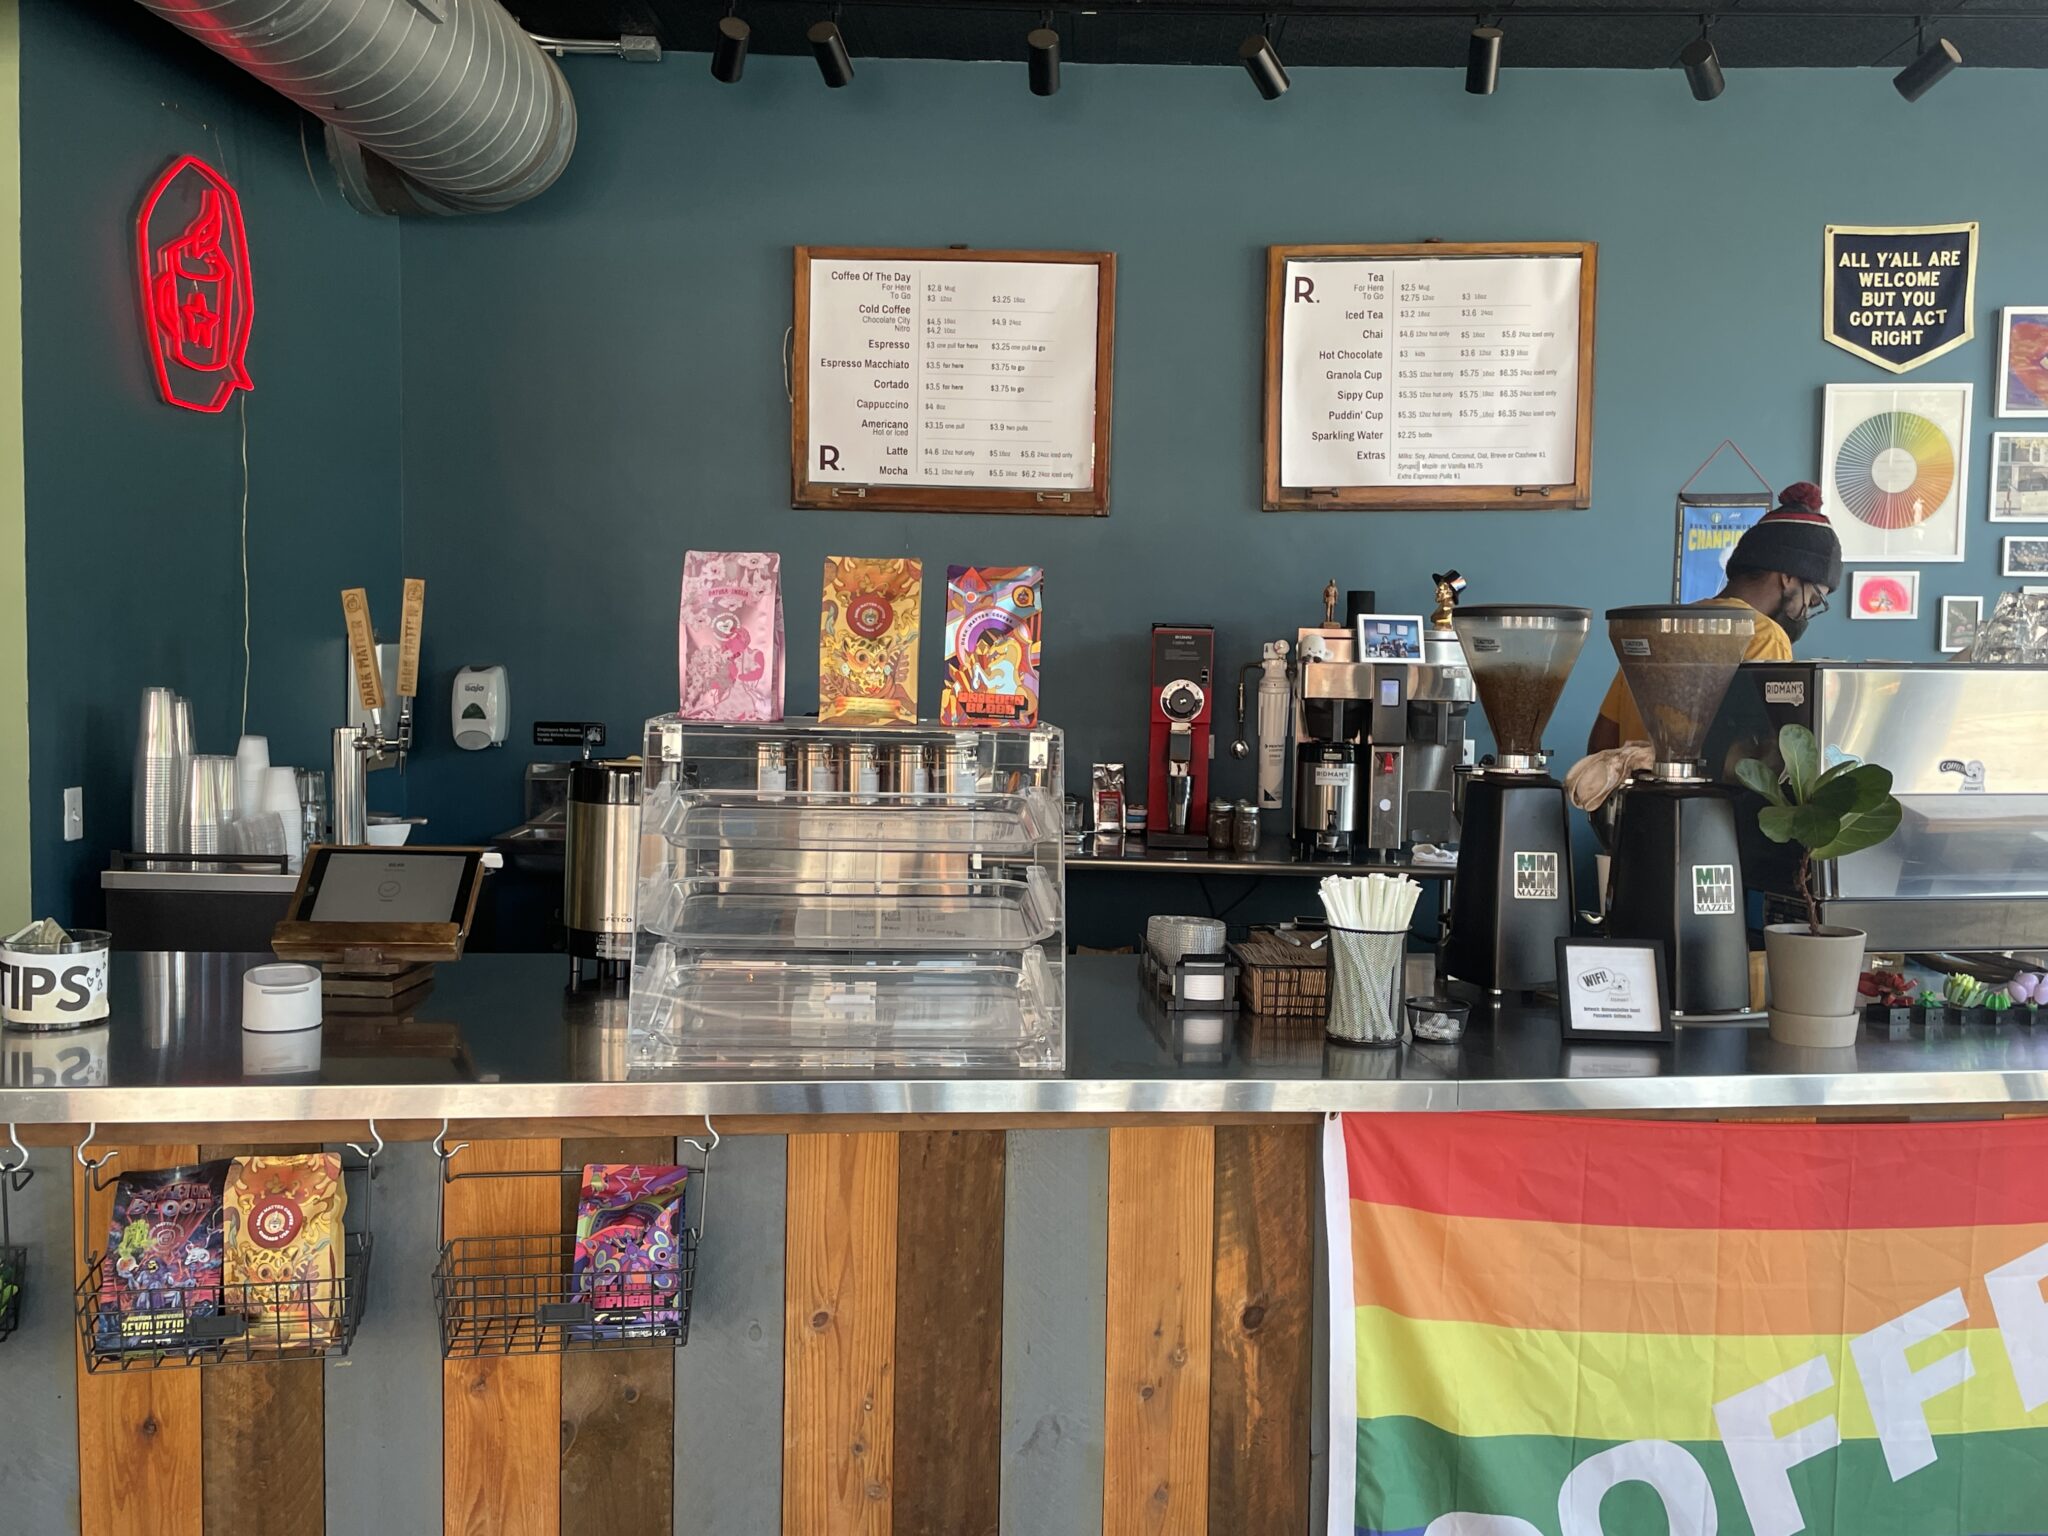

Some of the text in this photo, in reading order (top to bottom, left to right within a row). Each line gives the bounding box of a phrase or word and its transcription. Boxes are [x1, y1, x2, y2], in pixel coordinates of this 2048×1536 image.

[1839, 251, 1960, 267] ALL Y'ALL ARE
[831, 271, 911, 283] Coffee Of The Day
[1368, 273, 1384, 281] Tea
[1859, 271, 1940, 287] WELCOME
[1862, 291, 1935, 306] BUT YOU
[859, 304, 910, 314] Cold Coffee
[1346, 310, 1383, 319] Iced Tea
[1850, 309, 1947, 326] GOTTA ACT
[897, 317, 910, 325] City
[1362, 330, 1383, 338] Chai
[1871, 330, 1923, 345] RIGHT
[869, 340, 910, 350] Espresso
[1320, 350, 1382, 359] Hot Chocolate
[821, 359, 909, 368] Espresso Macchiato
[1326, 370, 1382, 380] Granola Cup
[874, 380, 909, 389] Cortado
[1338, 391, 1383, 401] Sippy Cup
[1460, 390, 1478, 398] $5.75
[857, 399, 908, 410] Cappuccino
[1329, 411, 1383, 421] Puddin' Cup
[1398, 411, 1416, 419] $5.35
[862, 419, 908, 429] Americano
[1312, 431, 1383, 442] Sparkling Water
[887, 446, 908, 455] Latte
[1357, 451, 1385, 460] Extras
[880, 466, 908, 475] Mocha
[968, 613, 988, 627] MATTER
[352, 621, 376, 706] DARK MATTER
[1767, 684, 1802, 694] RIDMAN'S
[1583, 971, 1608, 986] WIFI!
[0, 961, 90, 1012] TIPS
[256, 1212, 264, 1226] DARK
[284, 1208, 293, 1225] COFFEE
[279, 1230, 289, 1238] USA
